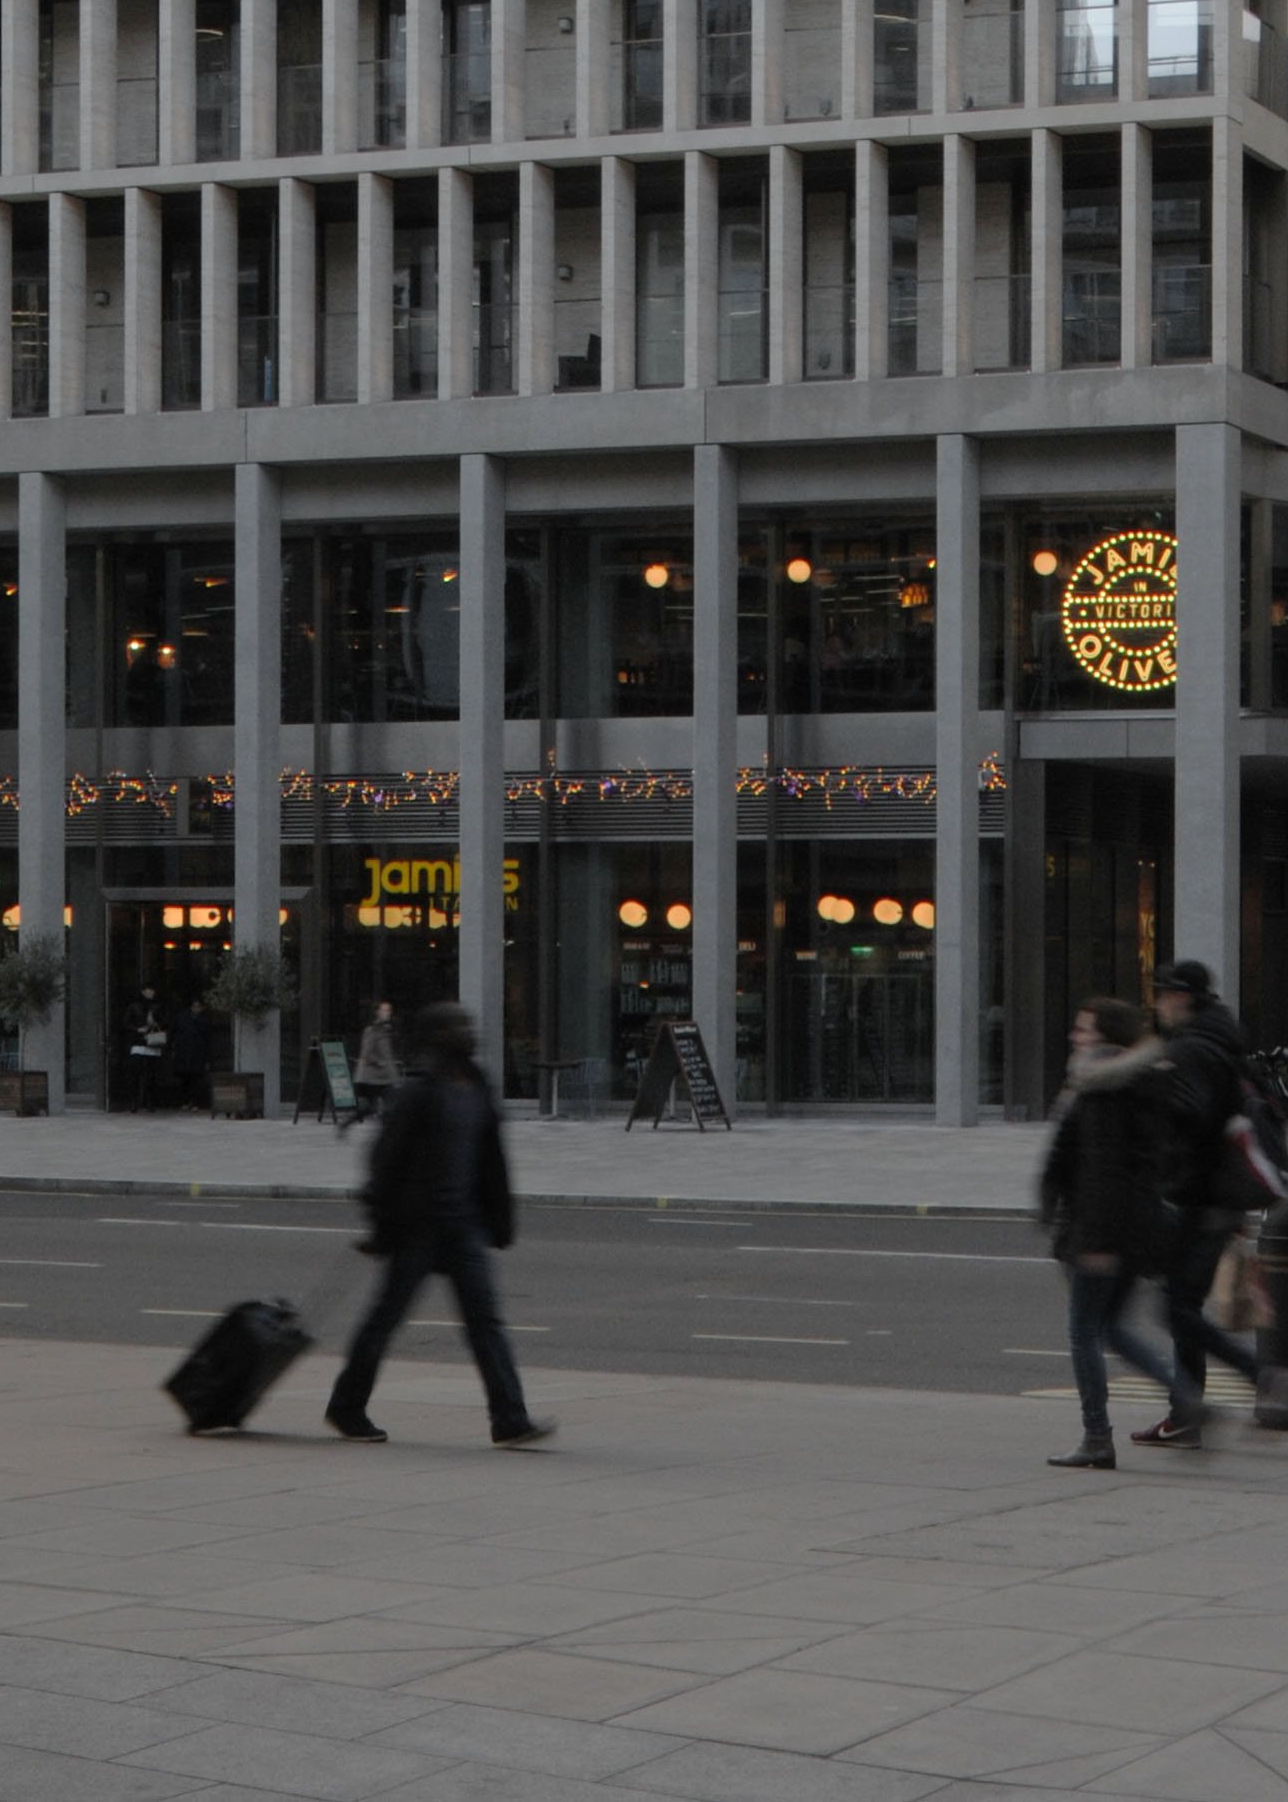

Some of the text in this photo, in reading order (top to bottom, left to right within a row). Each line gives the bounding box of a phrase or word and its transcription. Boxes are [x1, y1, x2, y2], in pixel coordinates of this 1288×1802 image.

[1133, 580, 1147, 593] IN
[1095, 603, 1172, 619] VICTORI
[1079, 634, 1177, 682] OLIVE
[362, 854, 520, 907] jamis
